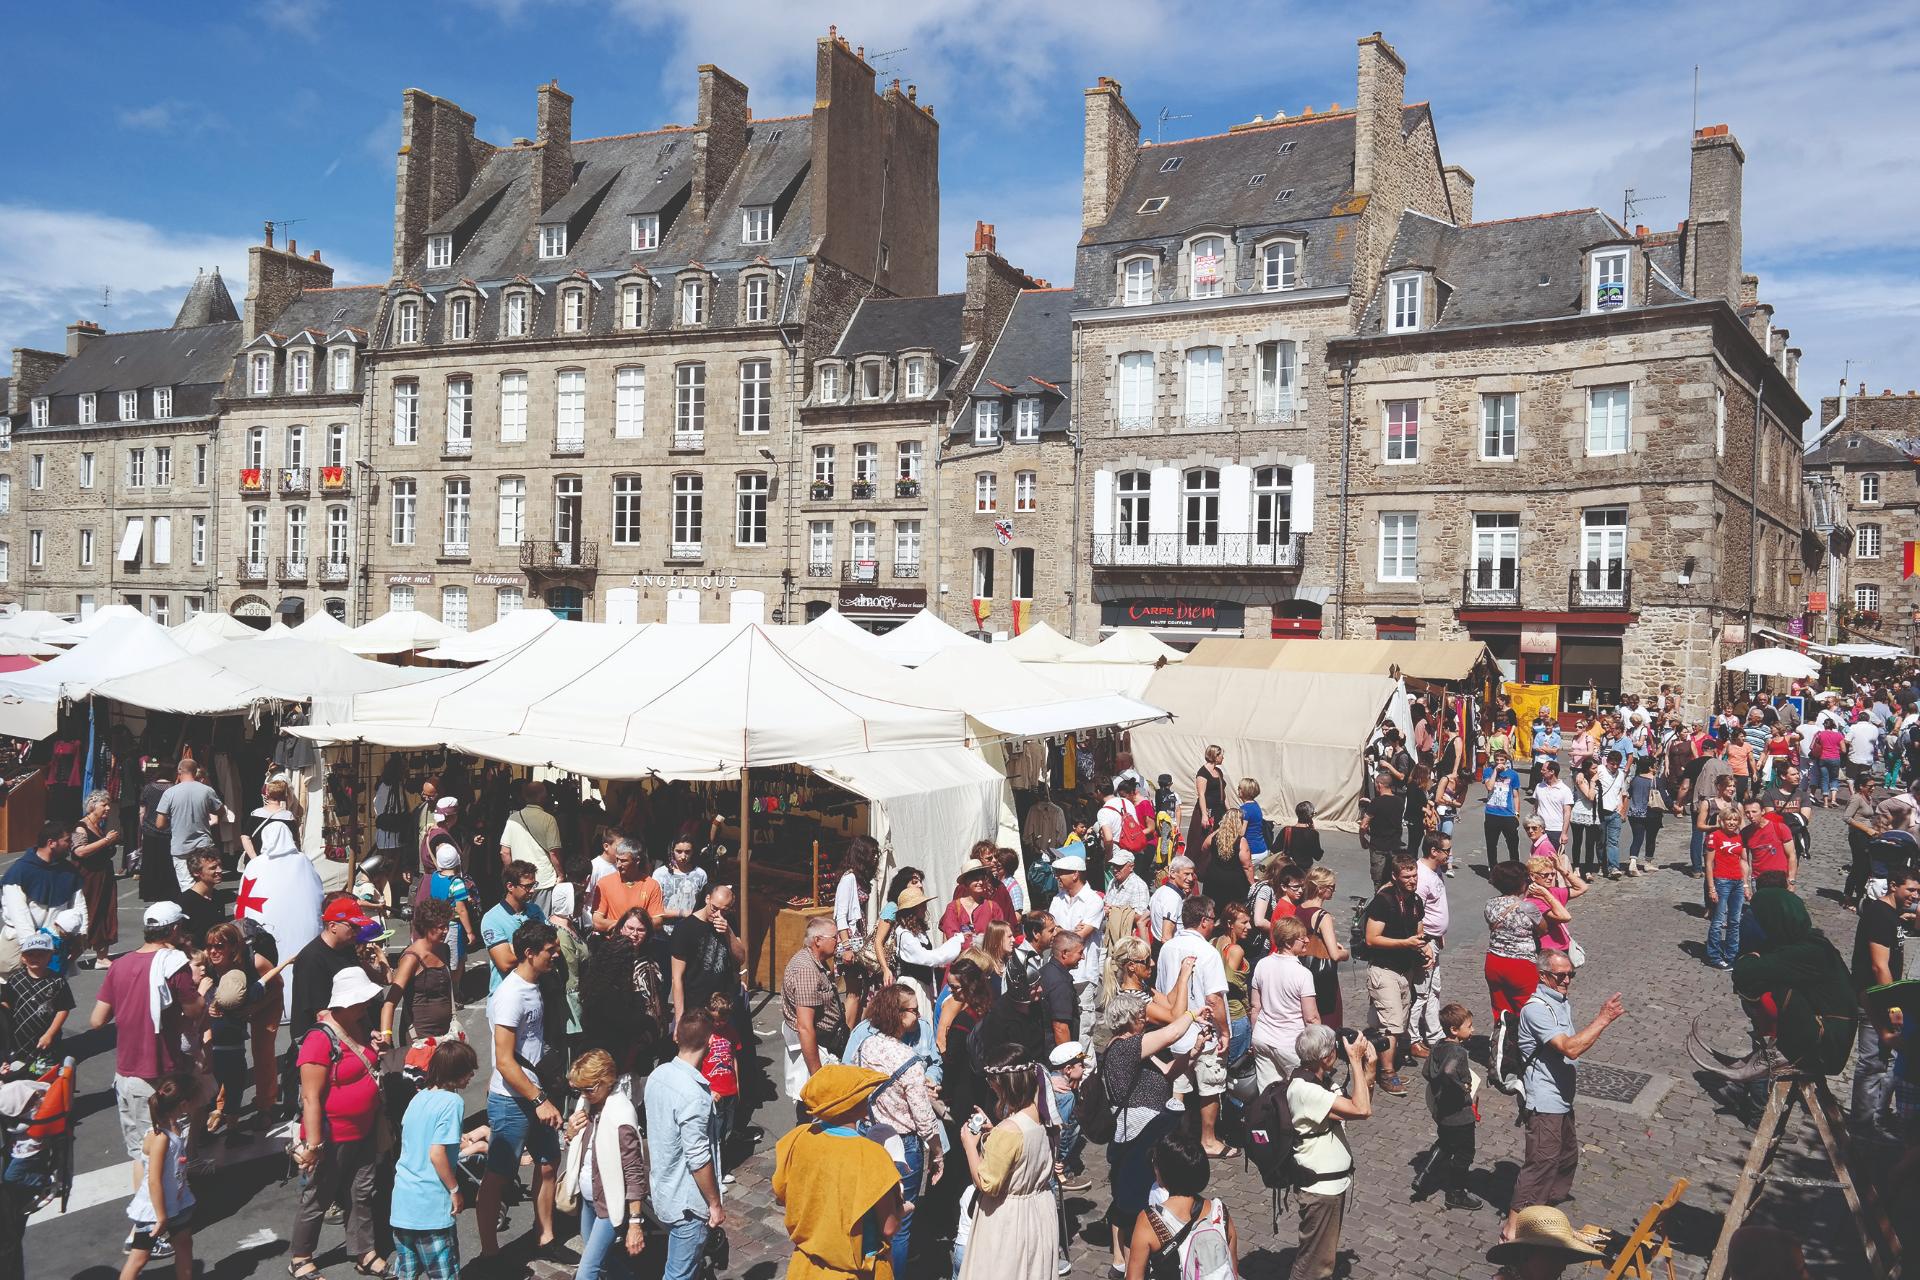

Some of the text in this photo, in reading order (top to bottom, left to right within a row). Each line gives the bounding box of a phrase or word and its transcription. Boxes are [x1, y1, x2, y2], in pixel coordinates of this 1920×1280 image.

[415, 575, 431, 584] moi
[474, 574, 518, 584] le chignon
